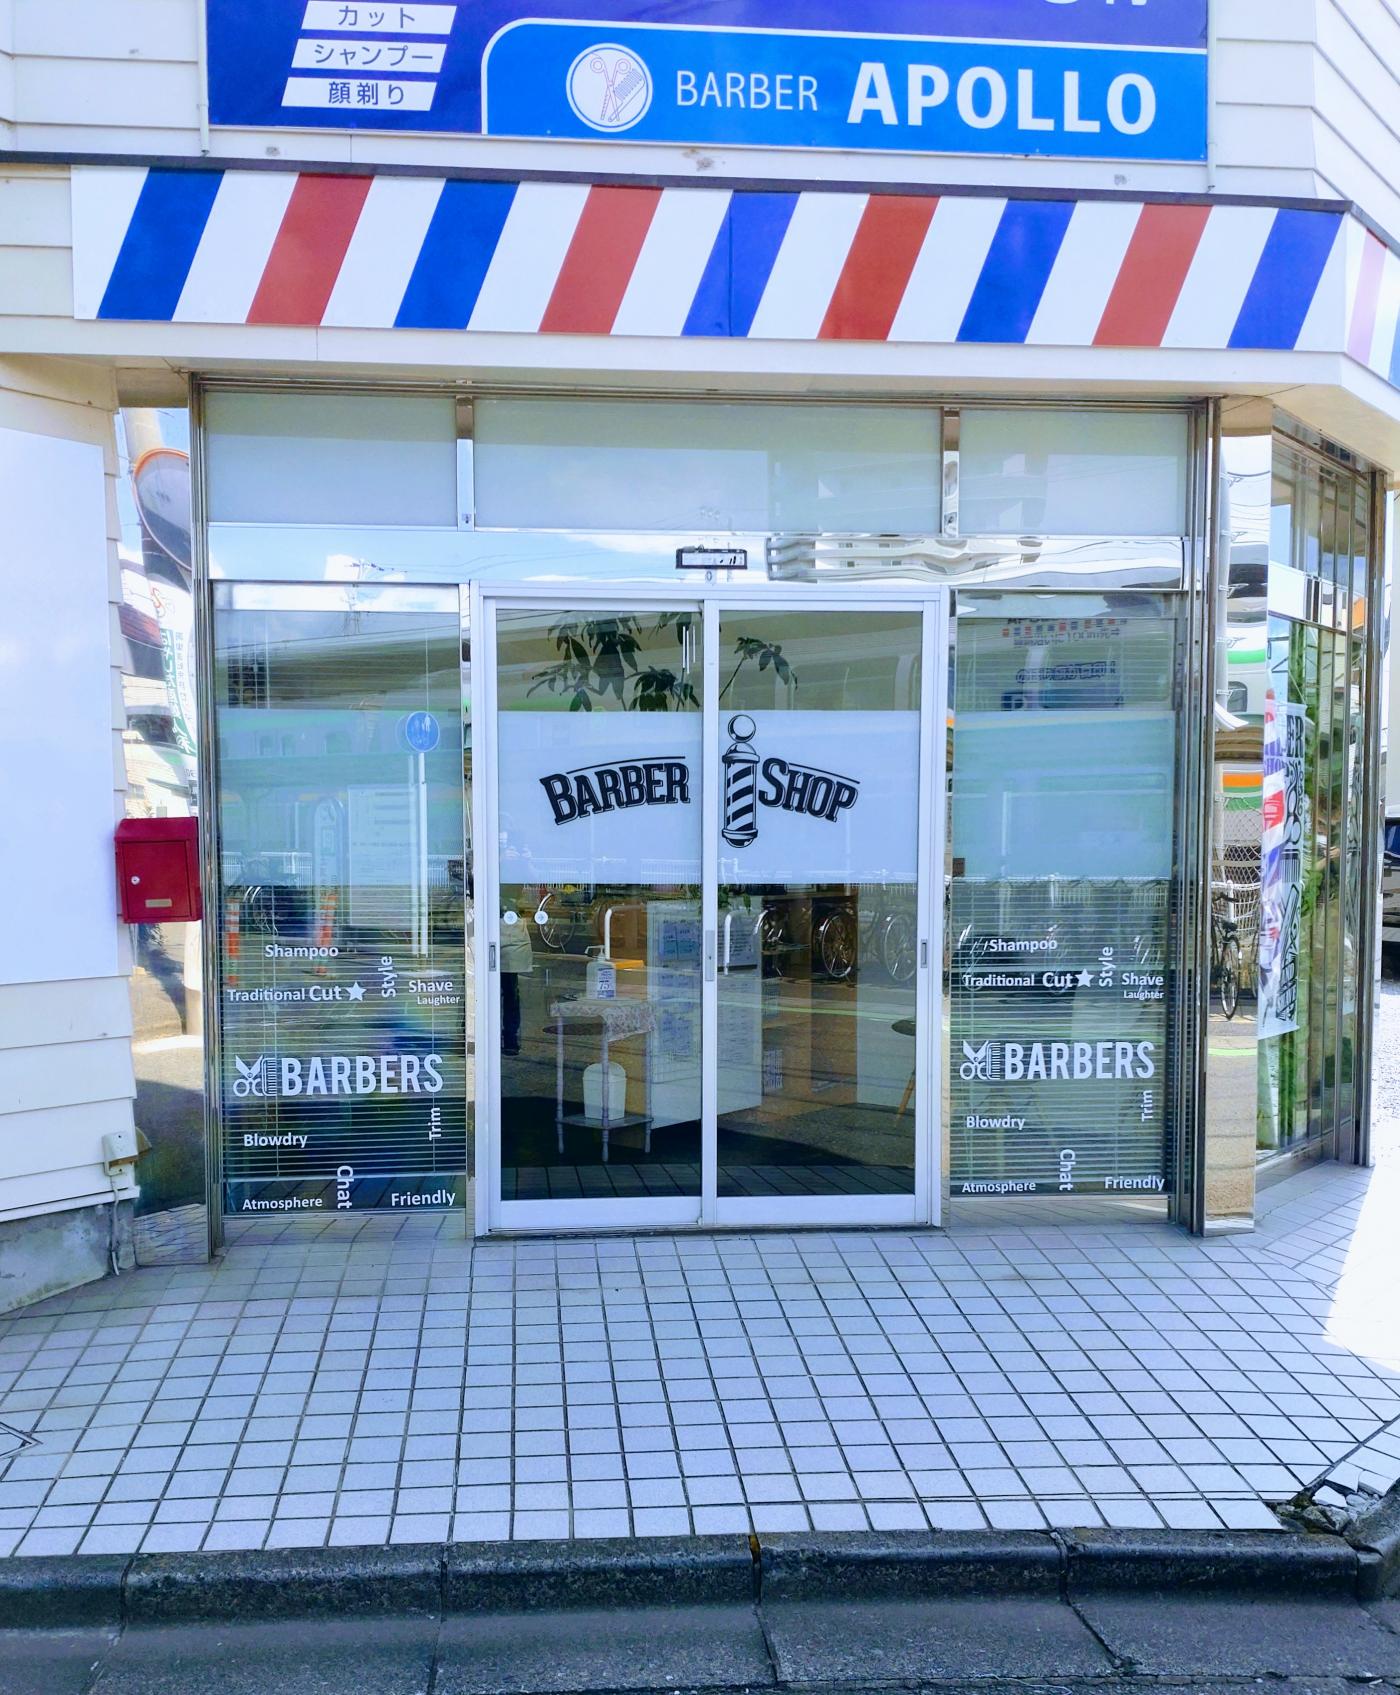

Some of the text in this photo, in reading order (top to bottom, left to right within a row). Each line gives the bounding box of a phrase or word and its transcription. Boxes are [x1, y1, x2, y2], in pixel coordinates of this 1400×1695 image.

[338, 5, 415, 29] カット
[314, 44, 433, 66] シャンプー
[328, 81, 404, 105] 顔剃り
[676, 61, 1157, 136] BARBER APOLLO
[539, 757, 860, 826] BARBER SHOP
[264, 944, 339, 960] Shampoo
[990, 938, 1058, 953] Shampoo
[1098, 946, 1117, 987] Style
[378, 955, 397, 998] Style
[963, 972, 1074, 988] Traditional Cut
[1121, 972, 1164, 986] Shave
[227, 985, 342, 1002] Traditional Cut
[408, 980, 453, 993] Shave
[1123, 990, 1165, 1000] Laughter
[417, 995, 460, 1006] Laughter
[1004, 1041, 1155, 1080] BARBERS
[281, 1053, 444, 1097] BARBERS
[1141, 1089, 1153, 1122] Trim
[428, 1107, 441, 1141] Trim
[966, 1115, 1025, 1130] Blowdry
[243, 1132, 308, 1148] Blowdry
[1059, 1149, 1076, 1191] Chat
[336, 1165, 354, 1209] Chat
[962, 1180, 1036, 1194] Atmosphere
[1104, 1176, 1165, 1191] Friendly
[242, 1196, 323, 1211] Atmosphere
[391, 1190, 456, 1207] Friendly
